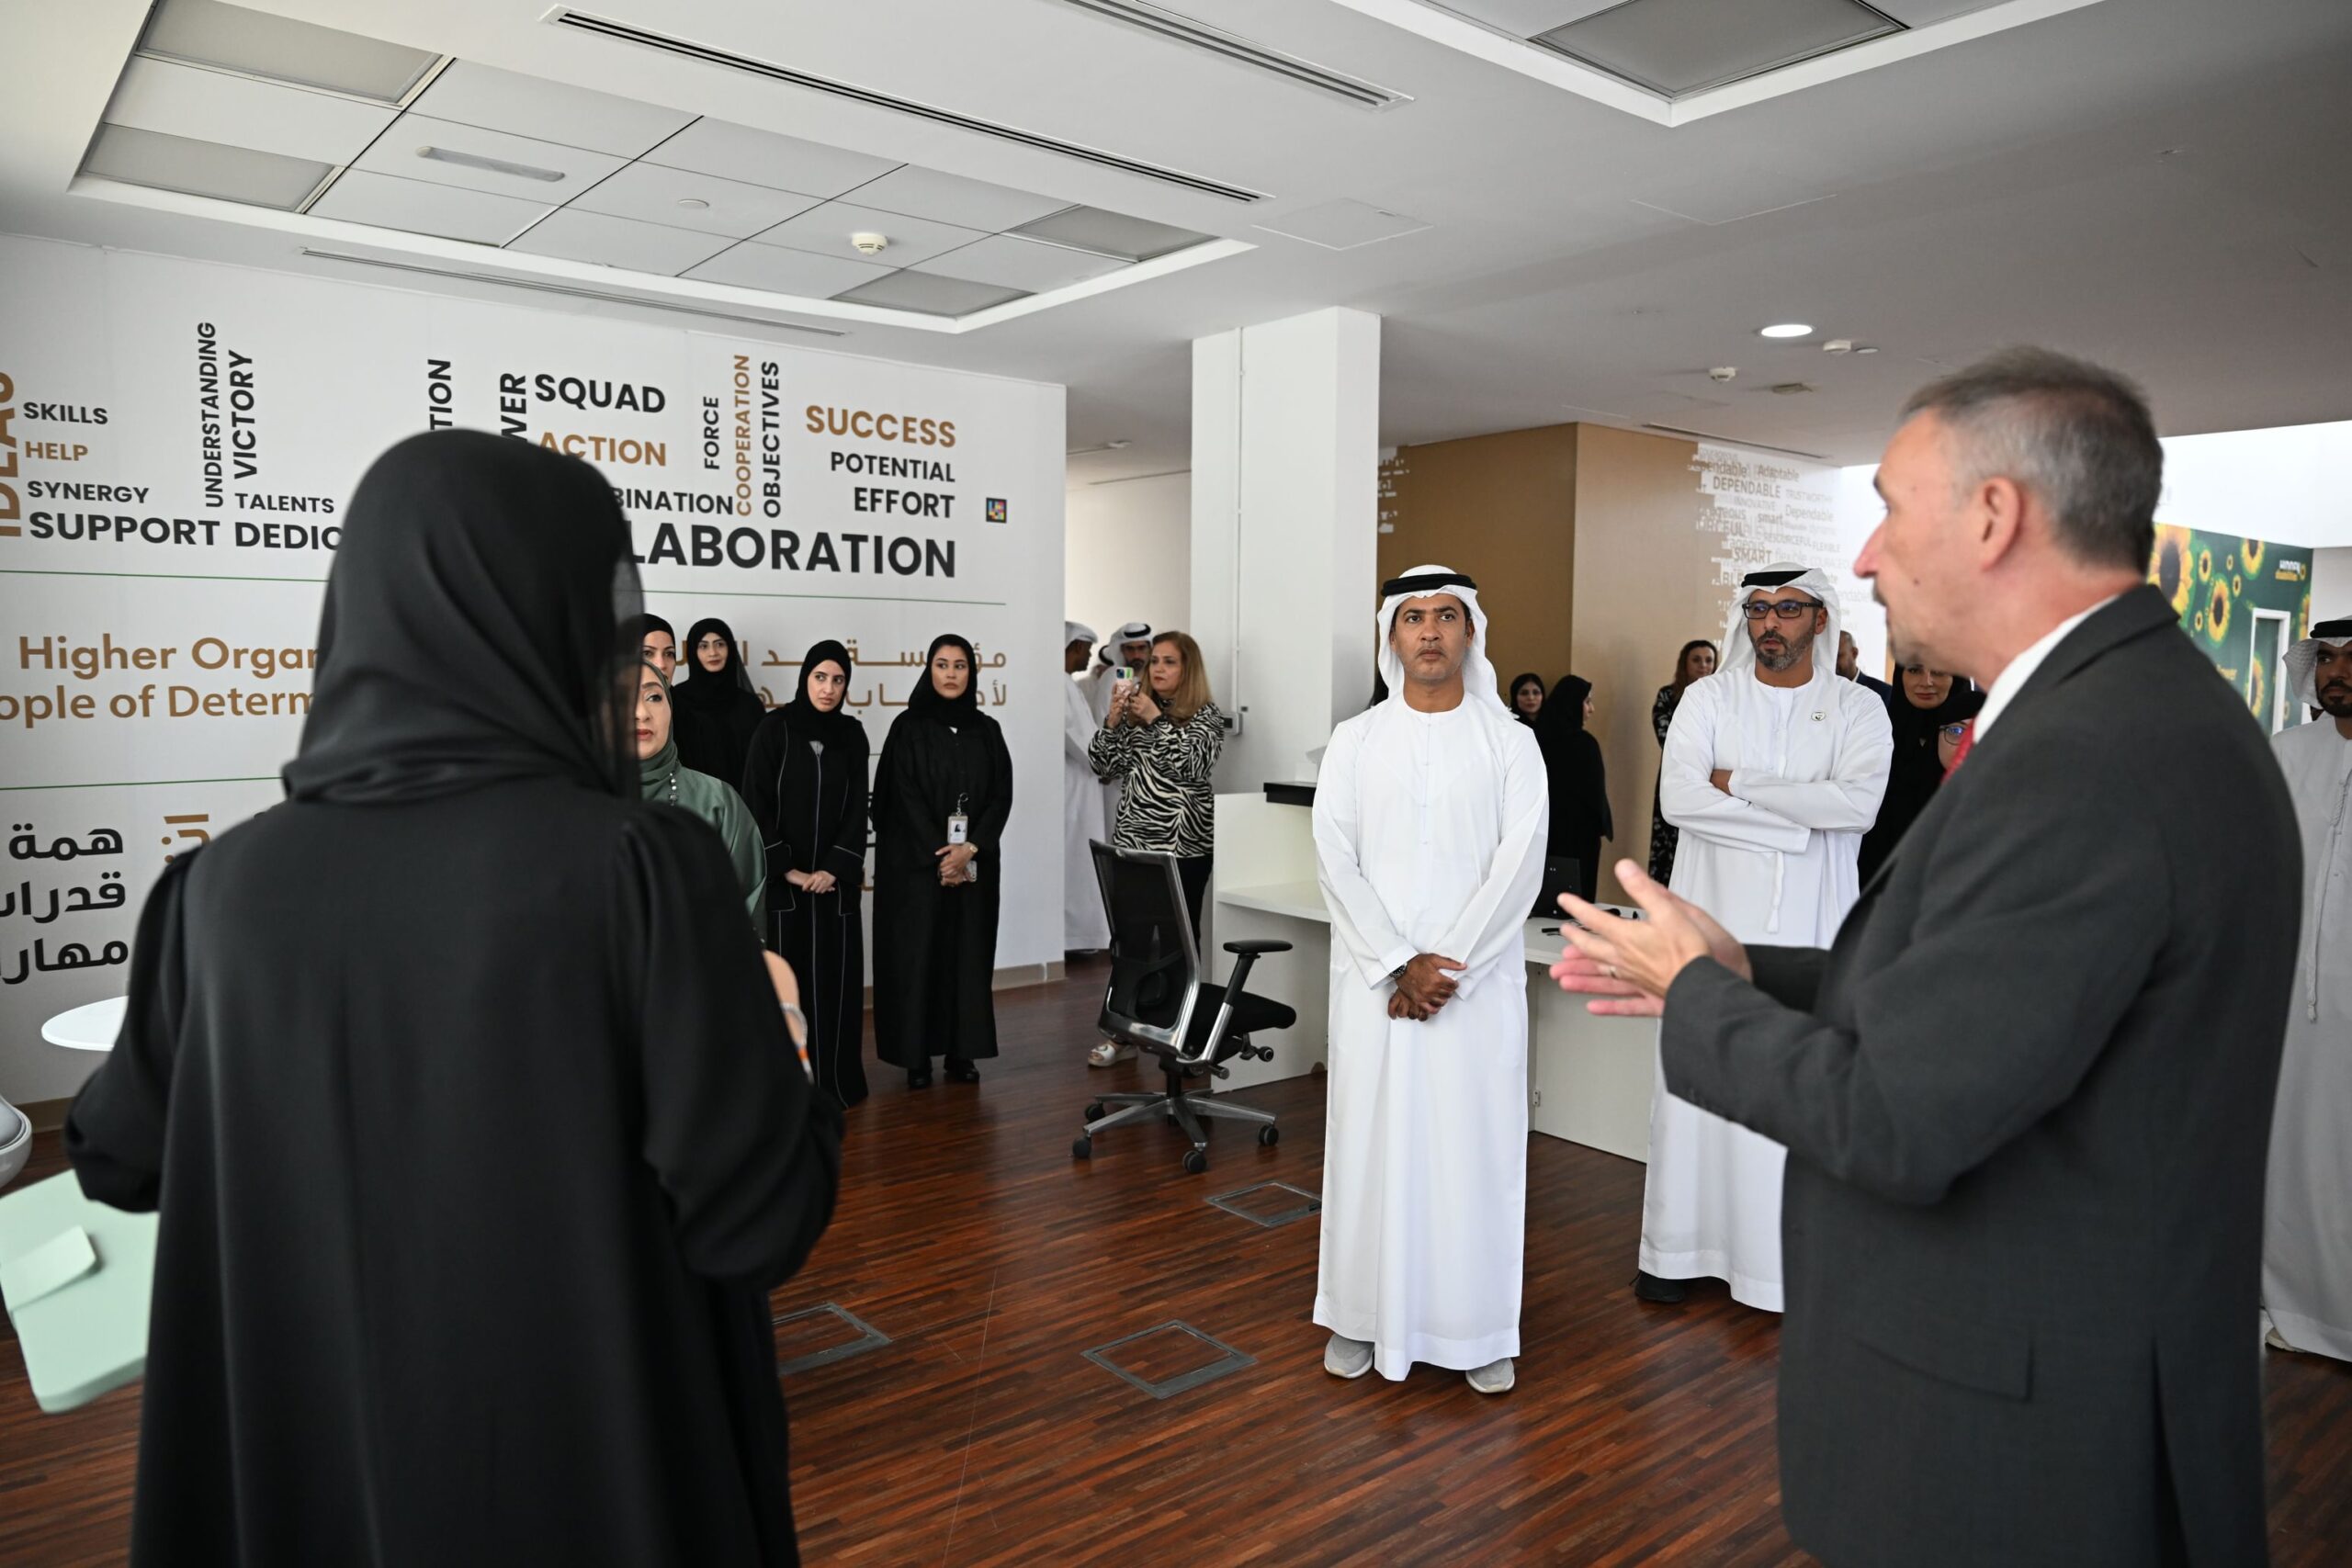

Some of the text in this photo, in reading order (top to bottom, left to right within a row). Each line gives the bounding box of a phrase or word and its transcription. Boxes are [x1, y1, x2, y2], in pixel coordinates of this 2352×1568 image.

[23, 401, 108, 424] SKILLS
[427, 358, 453, 431] TION
[535, 373, 666, 413] SQUAD
[198, 321, 223, 507] UNDERSTANDING
[229, 349, 258, 479] VICTORY
[703, 396, 720, 469] FORCE
[806, 405, 956, 447] SUCCESS
[25, 441, 88, 461] HELP
[540, 432, 667, 467] ACTION
[733, 355, 752, 516] COOPERATION
[761, 361, 781, 518] OBJECTIVES
[831, 451, 956, 482] POTENTIAL
[28, 480, 149, 503] SYNERGY
[234, 493, 334, 513] TALENTS
[611, 487, 733, 515] BINATION
[854, 487, 956, 519] EFFORT
[1713, 476, 1781, 499] DEPENDABLE
[28, 512, 344, 551] SUPPORT DEDIC
[627, 520, 956, 578] LABORATION
[19, 633, 176, 680] Higher
[0, 685, 96, 728] ople
[109, 684, 155, 717] of
[8, 823, 123, 861] همة
[0, 872, 126, 923] قدرا
